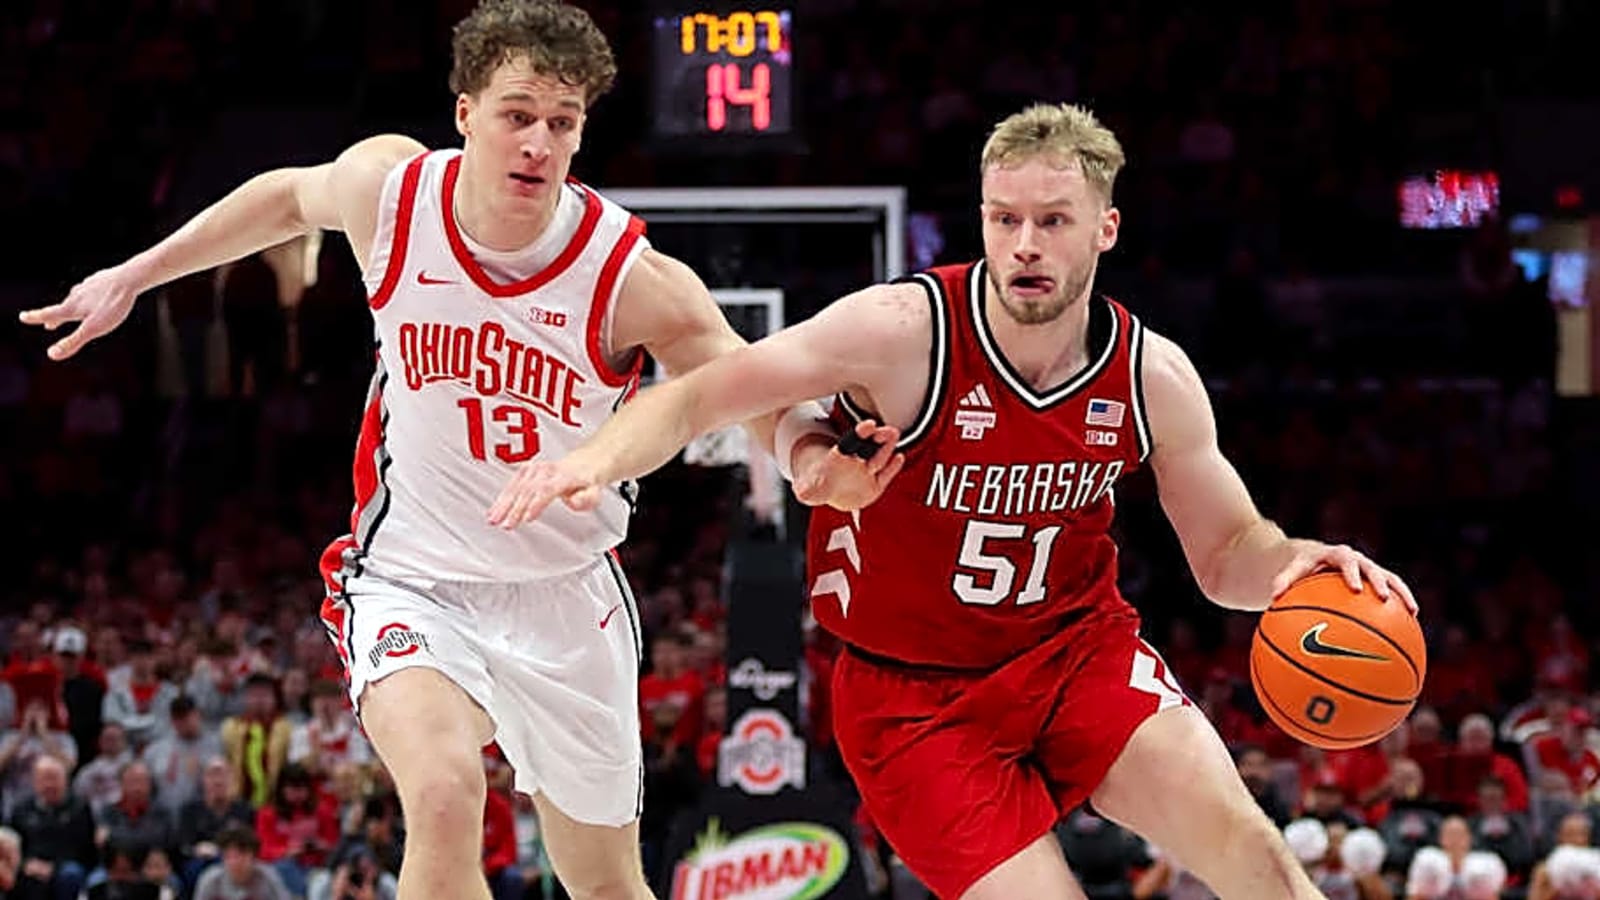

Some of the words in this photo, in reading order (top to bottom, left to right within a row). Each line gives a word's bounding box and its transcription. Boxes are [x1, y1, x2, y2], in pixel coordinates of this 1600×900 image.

[681, 11, 781, 56] 17:07
[707, 62, 770, 131] 14
[400, 323, 474, 390] OHIO
[475, 321, 586, 428] STATE
[457, 398, 540, 464] 13
[926, 460, 1125, 516] NEBRASKA
[952, 519, 1062, 606] 51
[670, 842, 829, 900] LIBMAN
